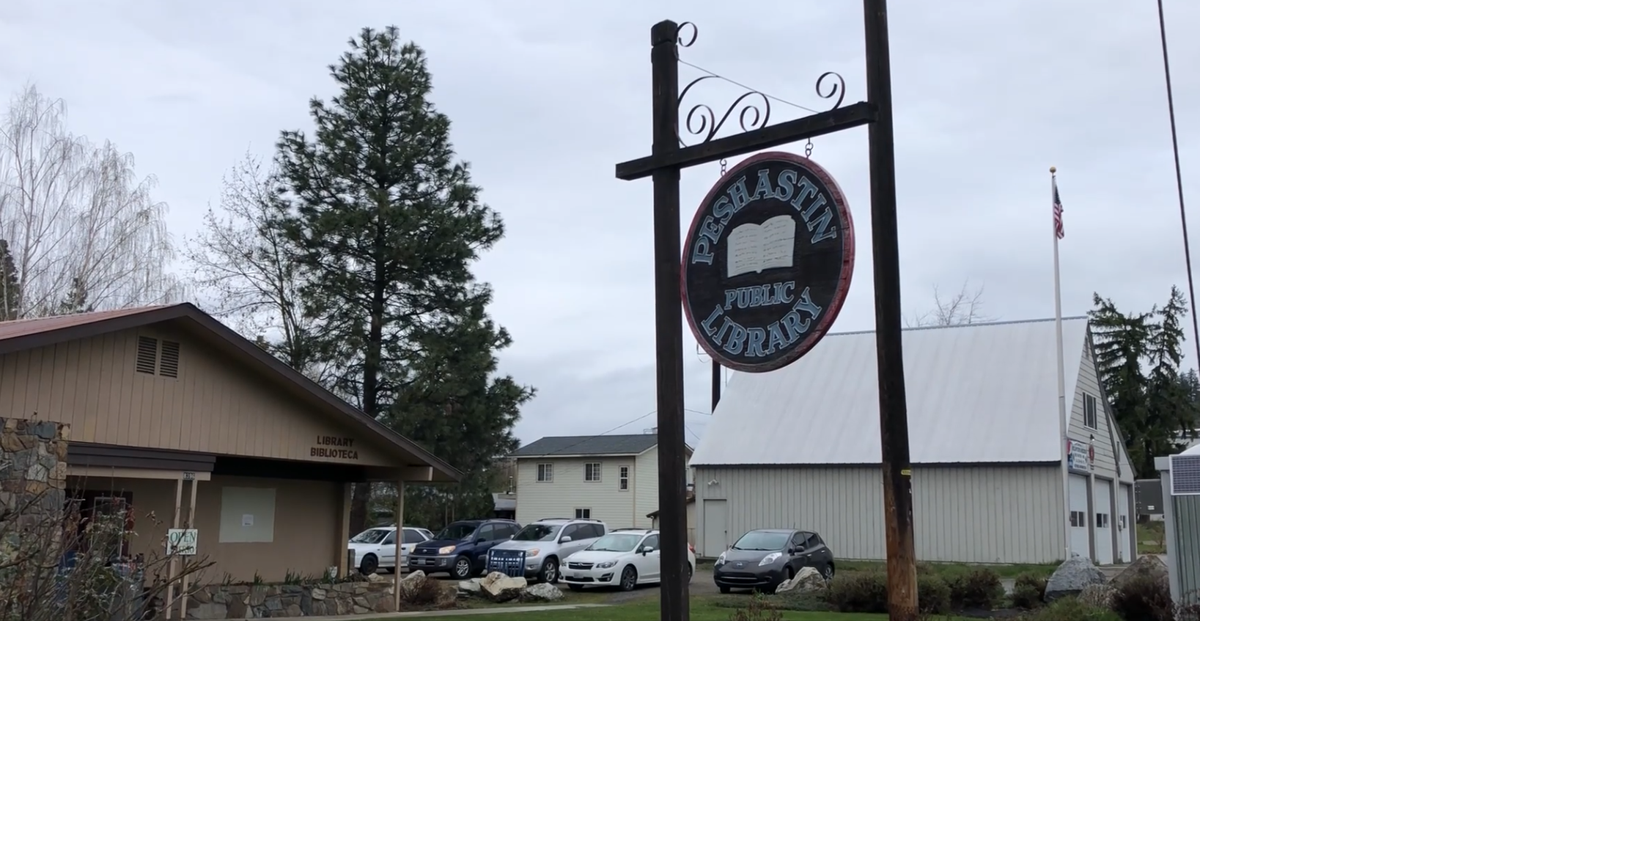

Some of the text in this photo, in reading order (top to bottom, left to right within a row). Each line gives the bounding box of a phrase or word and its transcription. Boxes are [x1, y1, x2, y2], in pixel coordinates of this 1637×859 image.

[692, 169, 837, 265] PESHASTIN
[724, 281, 796, 310] PUBLIC
[701, 287, 822, 357] LIBRARY
[310, 446, 359, 460] BIBLIOTECA
[316, 435, 355, 447] LIBRARY
